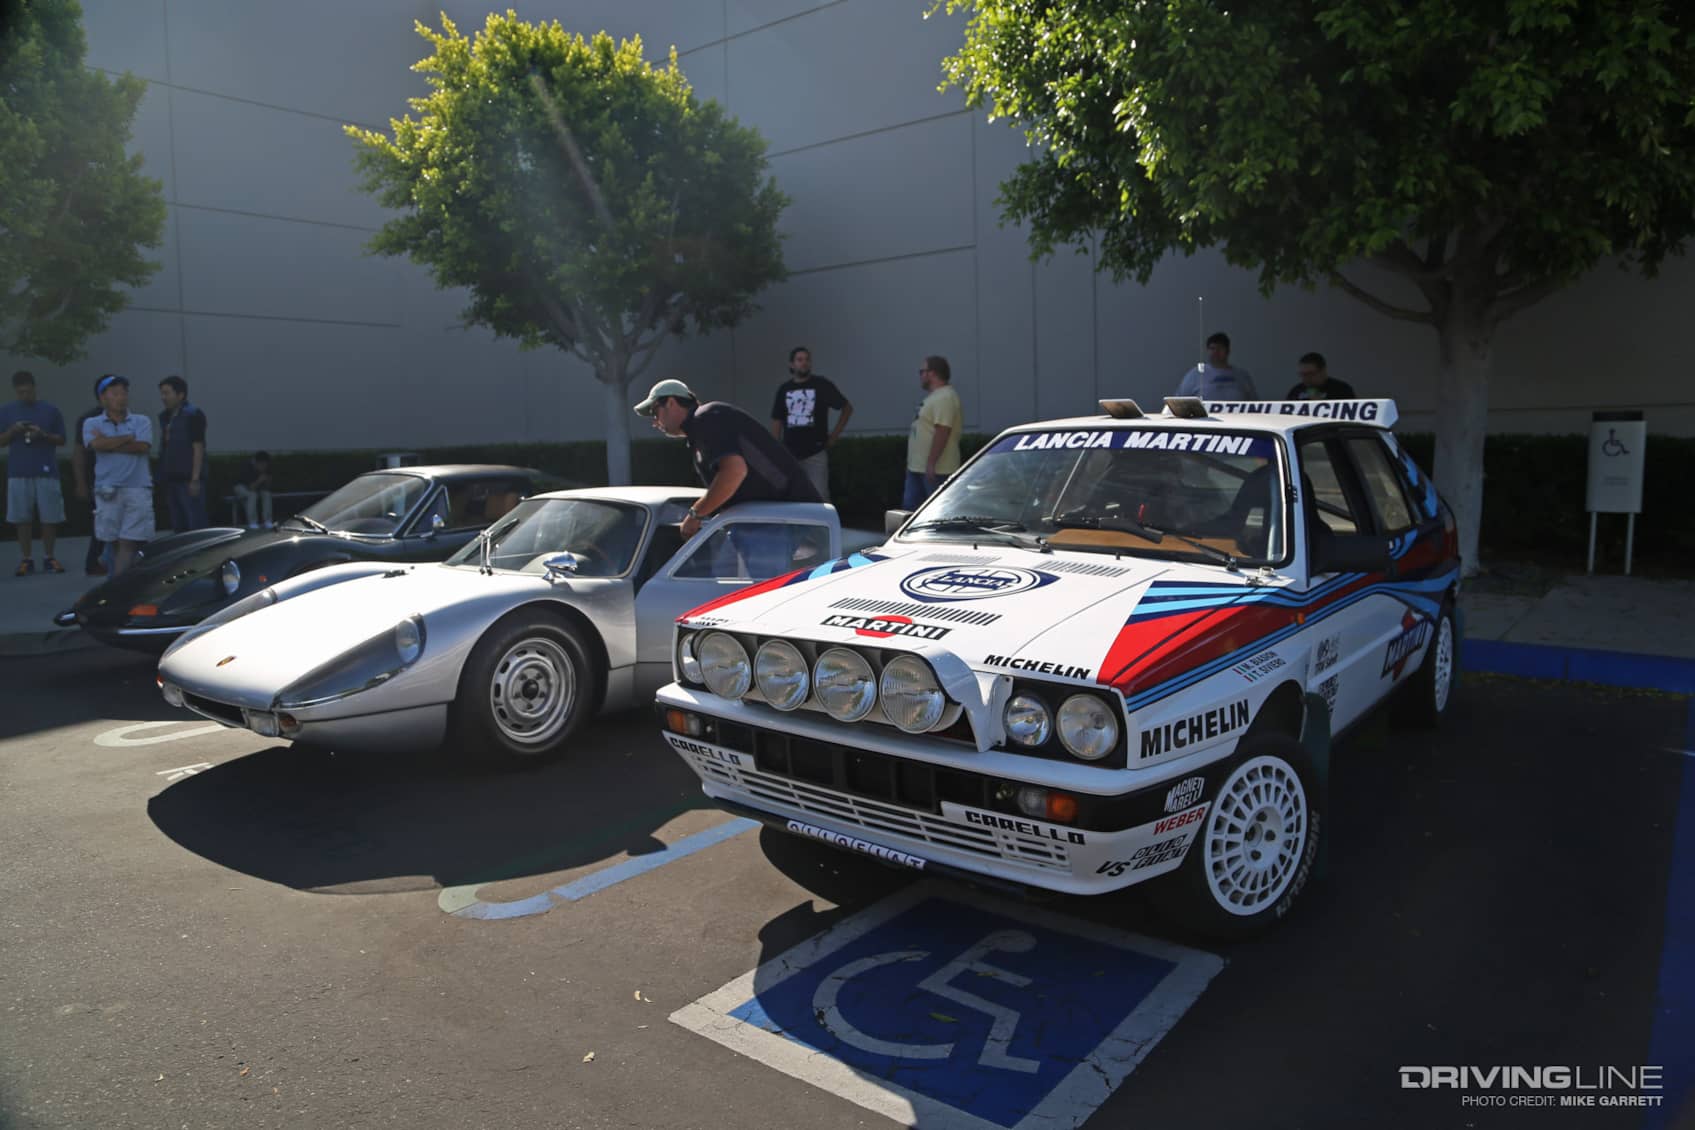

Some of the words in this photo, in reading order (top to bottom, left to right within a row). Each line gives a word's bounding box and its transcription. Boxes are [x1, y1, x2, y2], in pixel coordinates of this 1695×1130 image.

[1208, 403, 1272, 414] RTINI
[1279, 401, 1378, 421] RACING
[1013, 431, 1114, 451] LANCIA
[1122, 431, 1254, 456] MARTINI
[826, 615, 944, 640] MARTINI
[983, 654, 1091, 681] MICHELIN
[1140, 698, 1250, 759] MICHELIN
[669, 737, 741, 766] CARELLO
[965, 810, 1086, 846] CARELLO
[1153, 806, 1206, 836] WEBER
[1095, 861, 1131, 877] VS
